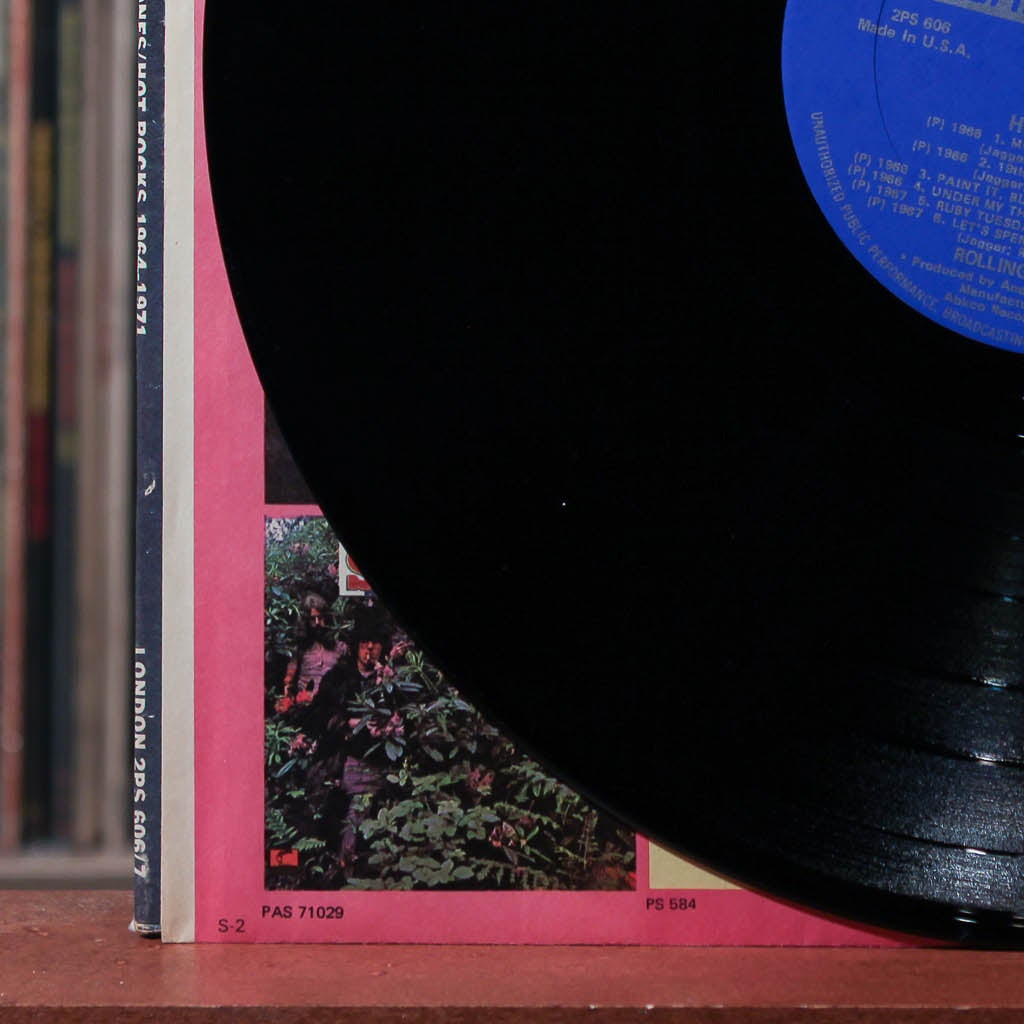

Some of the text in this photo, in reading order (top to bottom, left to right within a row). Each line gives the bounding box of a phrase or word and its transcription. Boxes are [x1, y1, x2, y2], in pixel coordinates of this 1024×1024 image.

[890, 8, 952, 34] 2PS 606
[858, 17, 897, 39] Made
[922, 34, 973, 59] U.S.A.
[853, 151, 872, 167] (P)
[919, 168, 933, 181] 3.
[937, 173, 980, 193] PAINT
[978, 157, 992, 169] 2.
[811, 112, 845, 203] UNAUTHORIZED
[840, 204, 872, 246] PUBLIC
[847, 164, 866, 179] (P)
[931, 185, 981, 207] UNDER
[984, 199, 1003, 213] MY
[851, 178, 871, 193] (P)
[936, 200, 972, 218] RUBY
[952, 218, 990, 237] LET'S
[911, 257, 974, 282] Produced
[978, 275, 995, 289] by
[262, 906, 344, 918] PAS 71029
[646, 898, 696, 910] PS 584
[218, 919, 245, 933] S-2
